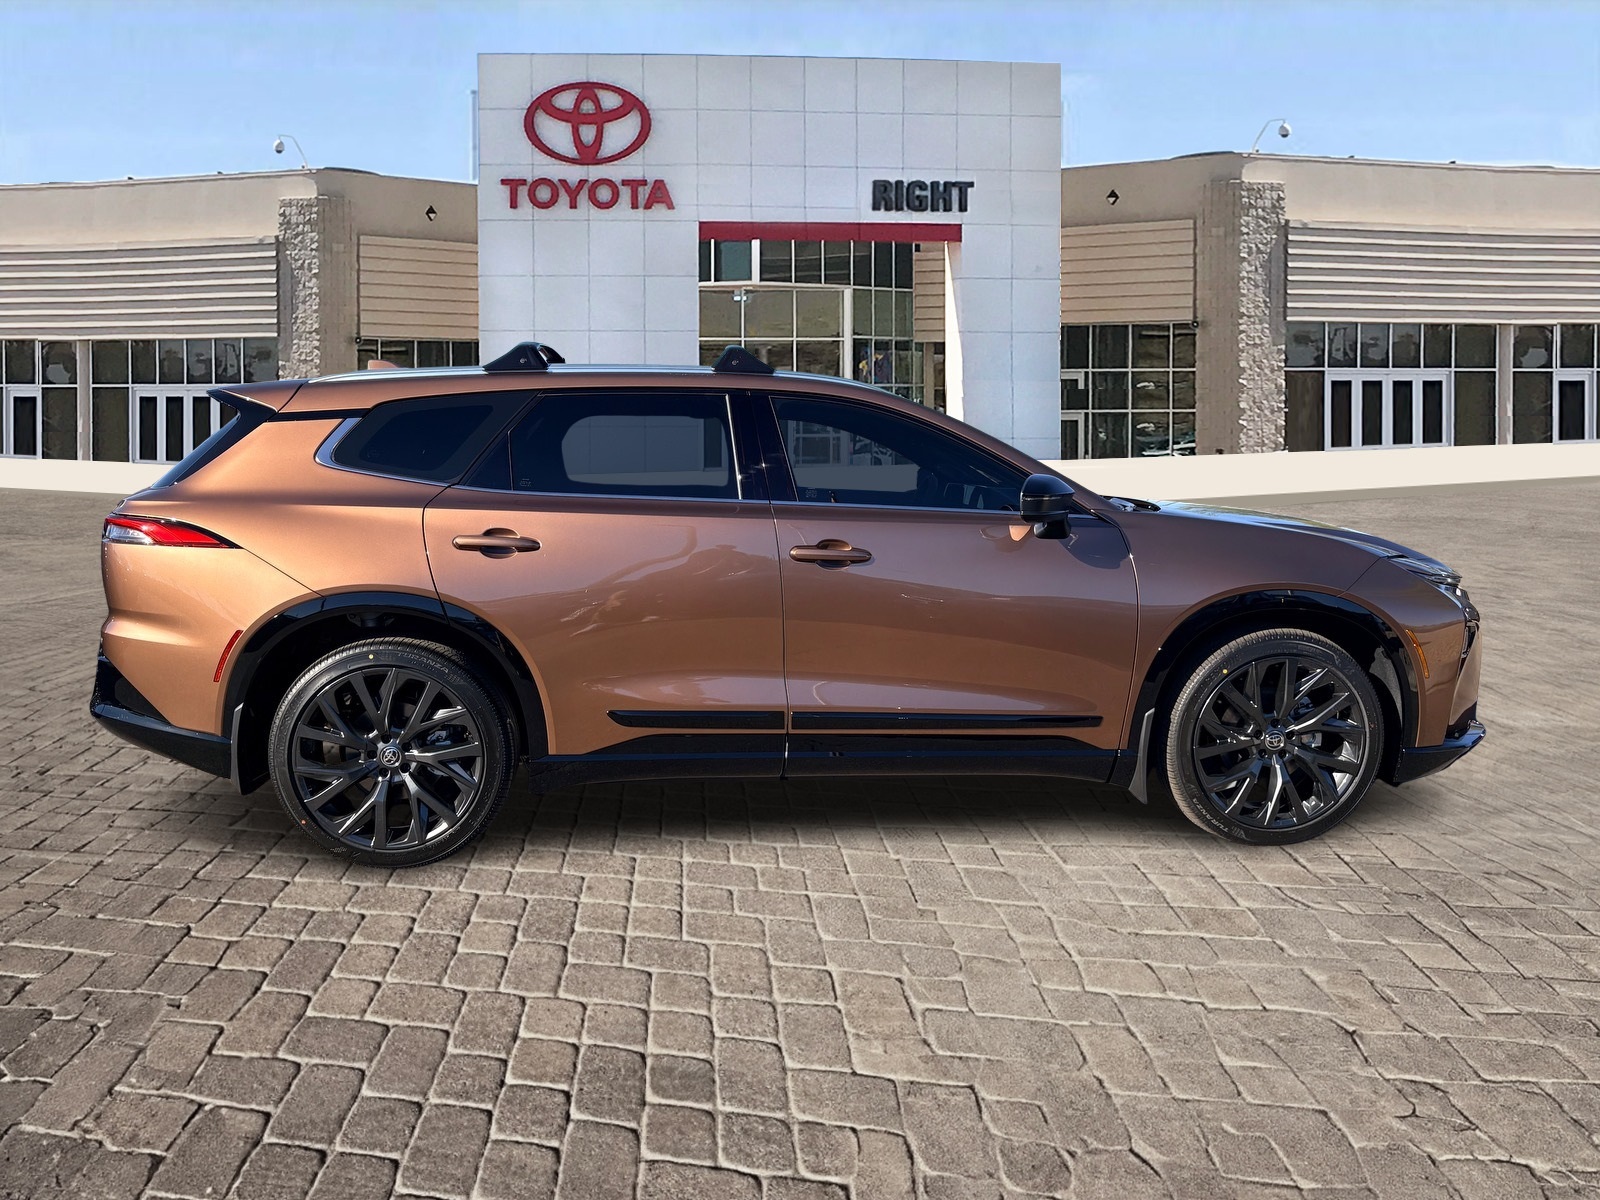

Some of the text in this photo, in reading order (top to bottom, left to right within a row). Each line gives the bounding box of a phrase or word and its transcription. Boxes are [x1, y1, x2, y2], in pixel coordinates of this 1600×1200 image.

[500, 178, 675, 210] TOYOTA
[872, 179, 975, 213] RIGHT
[397, 652, 449, 673] TURANZA
[1192, 797, 1229, 833] TURANZA
